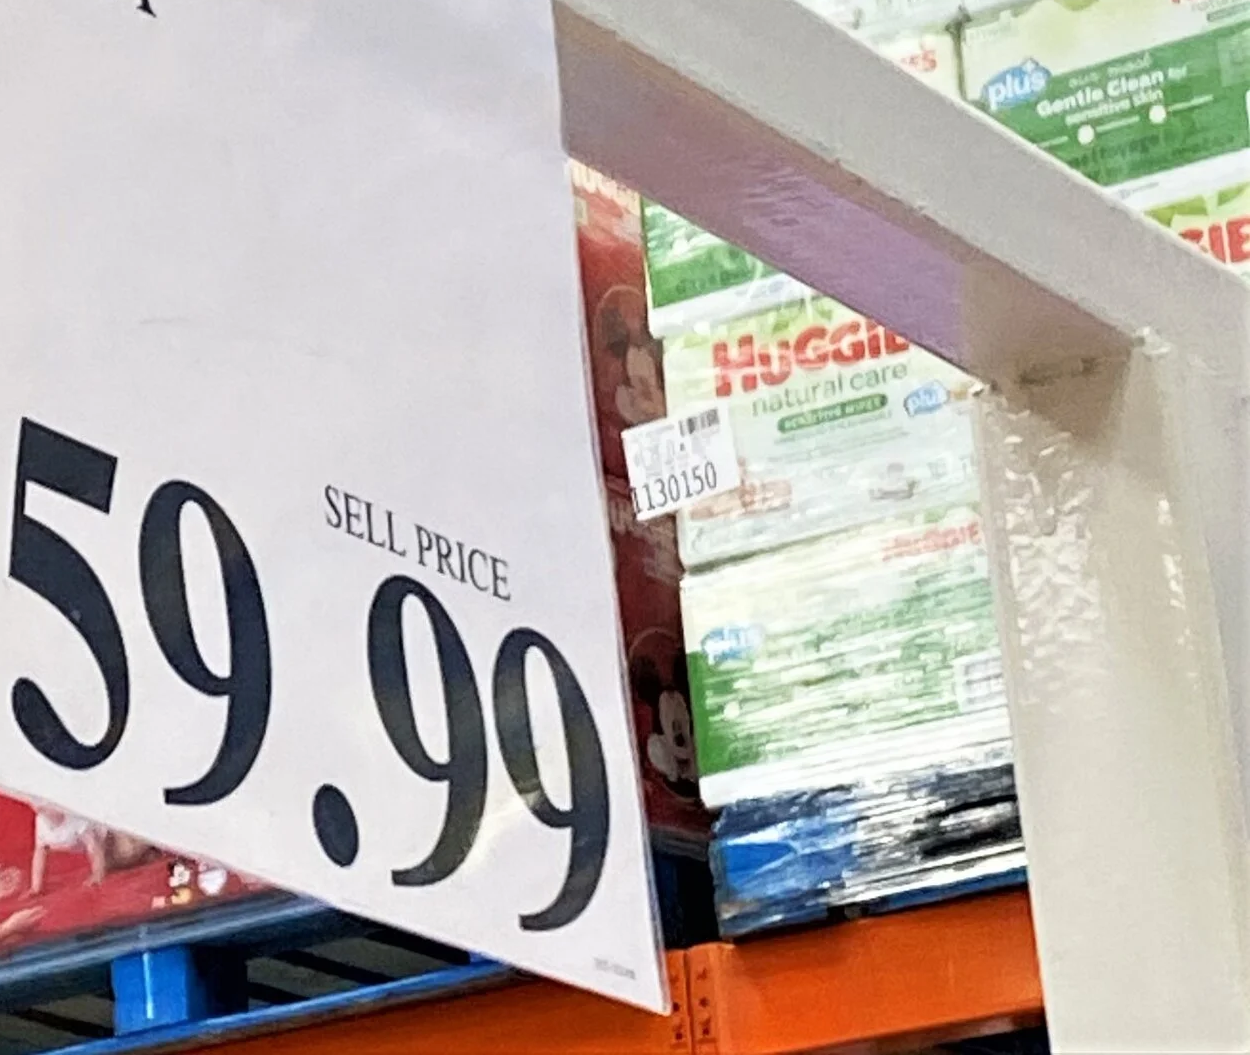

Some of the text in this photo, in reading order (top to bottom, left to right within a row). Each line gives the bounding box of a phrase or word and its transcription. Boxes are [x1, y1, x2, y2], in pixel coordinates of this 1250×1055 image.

[988, 60, 1050, 113] plus
[1036, 86, 1103, 118] Gentle
[1107, 70, 1165, 97] Clean
[751, 371, 844, 417] natural
[850, 362, 908, 390] care
[631, 460, 718, 517] 1130150
[324, 484, 512, 601] SELL PRICE
[10, 417, 611, 932] 59.99
